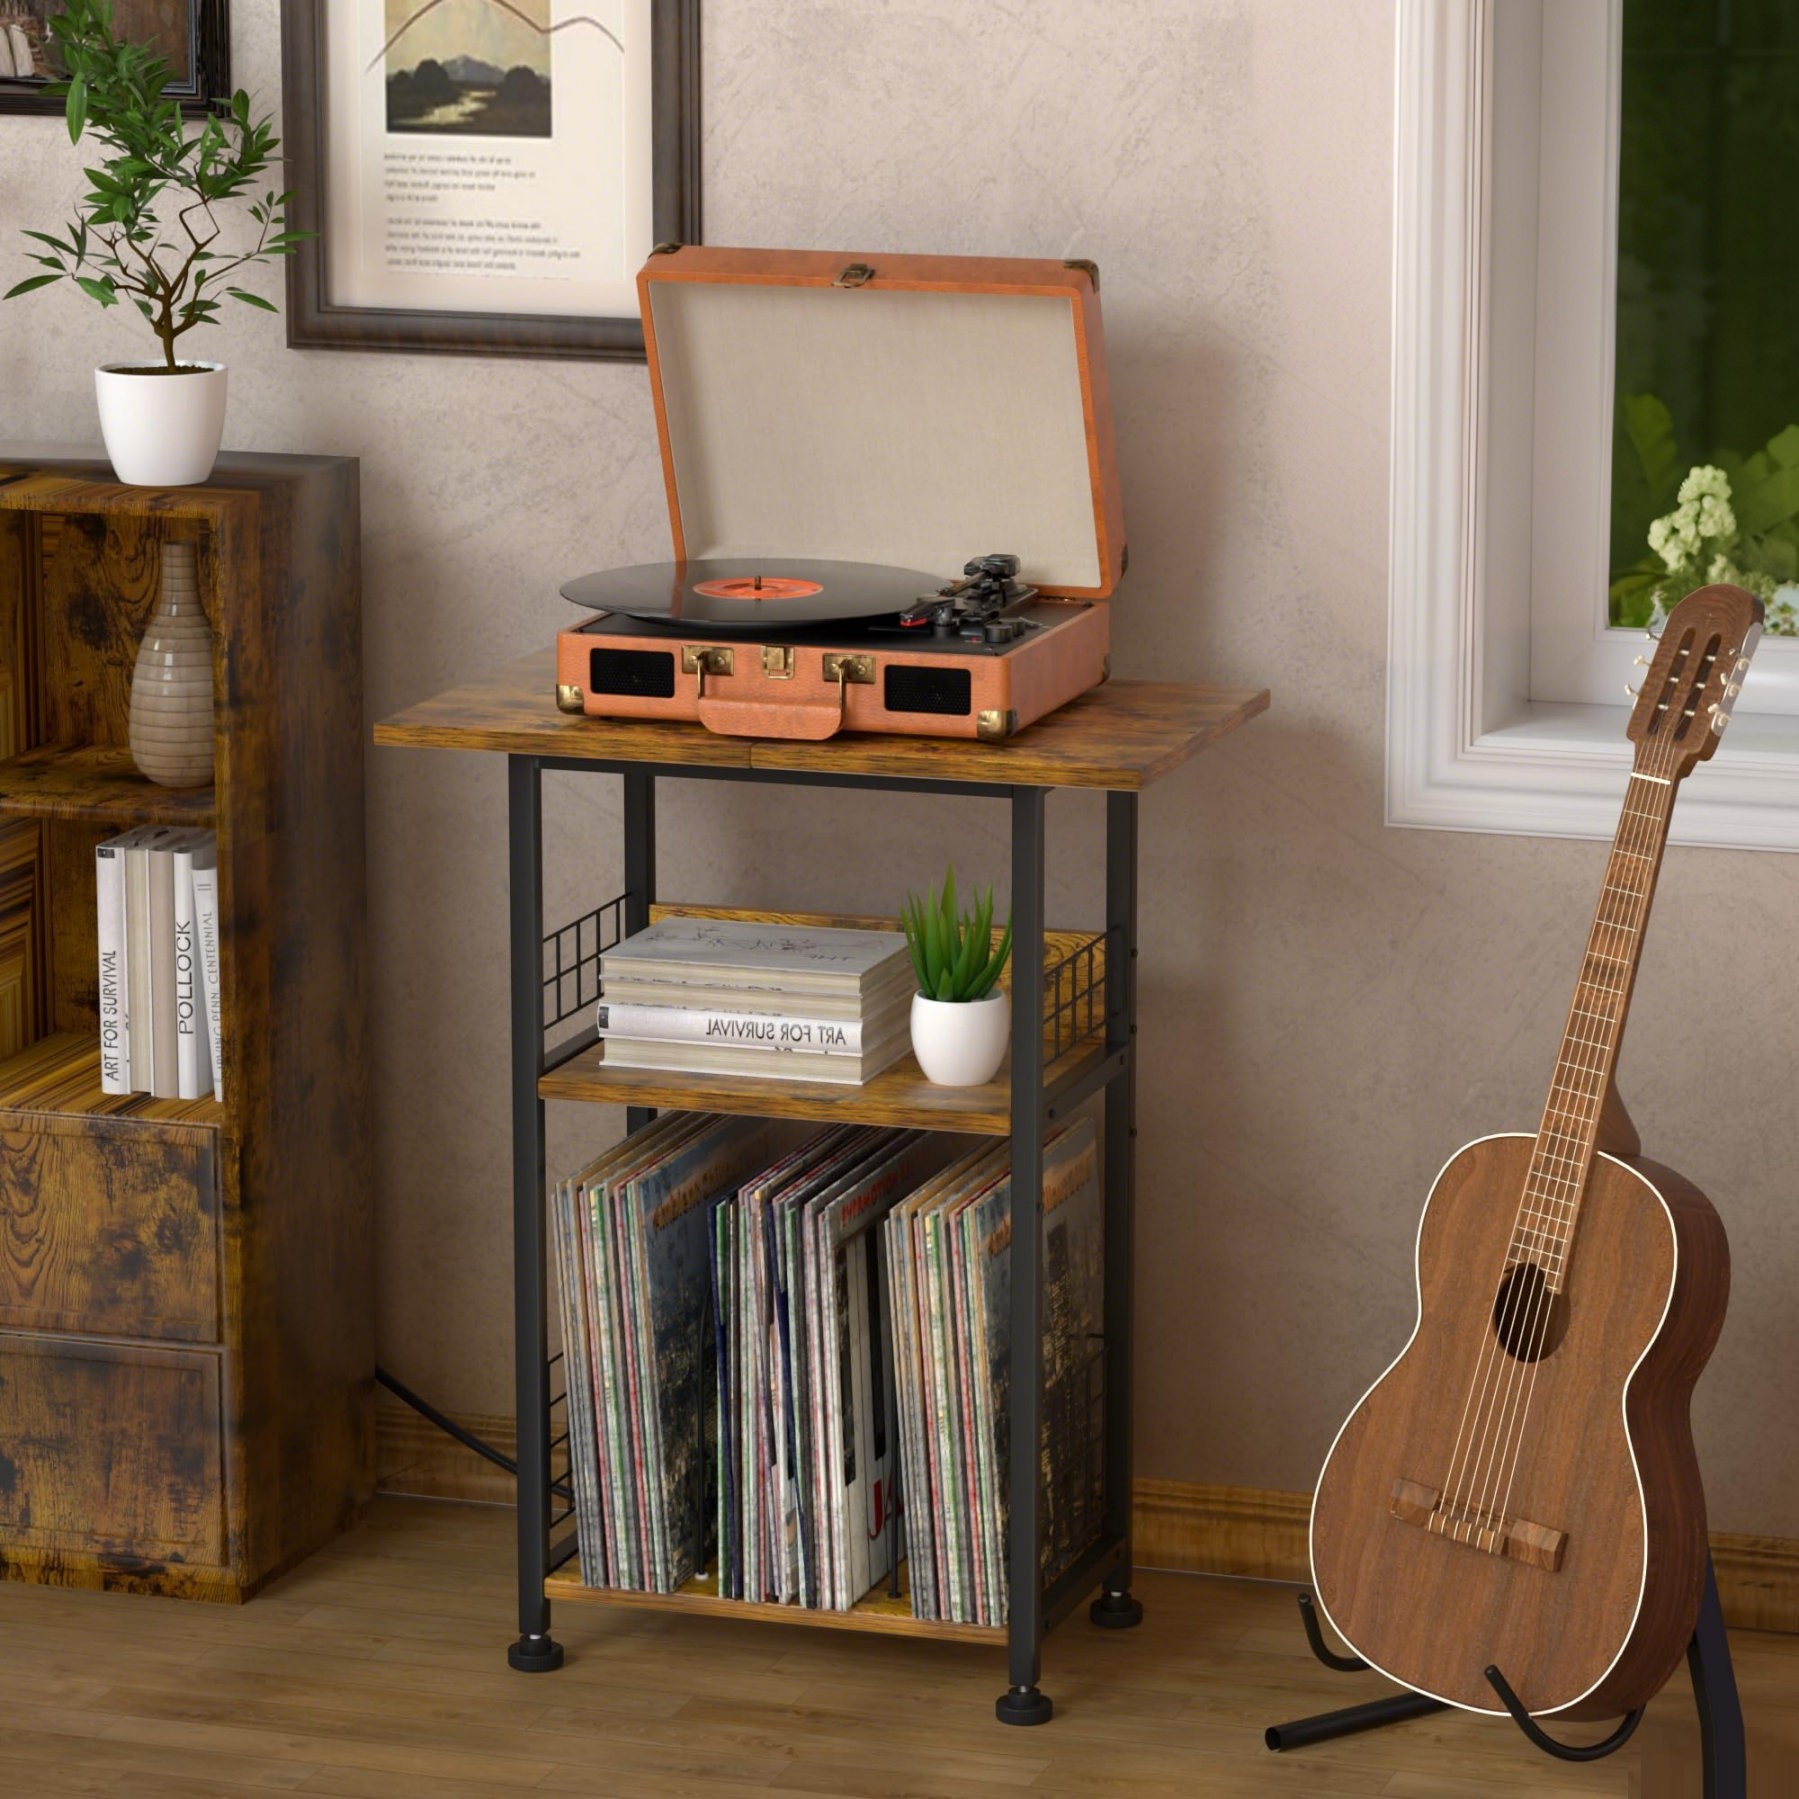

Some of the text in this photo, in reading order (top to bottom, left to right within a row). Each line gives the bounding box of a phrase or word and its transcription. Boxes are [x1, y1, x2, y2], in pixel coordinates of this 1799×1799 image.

[176, 920, 193, 1035] POLLOCK
[203, 911, 219, 985] CENTENNIAL
[102, 950, 119, 1081] ART FOR SURVIVAL
